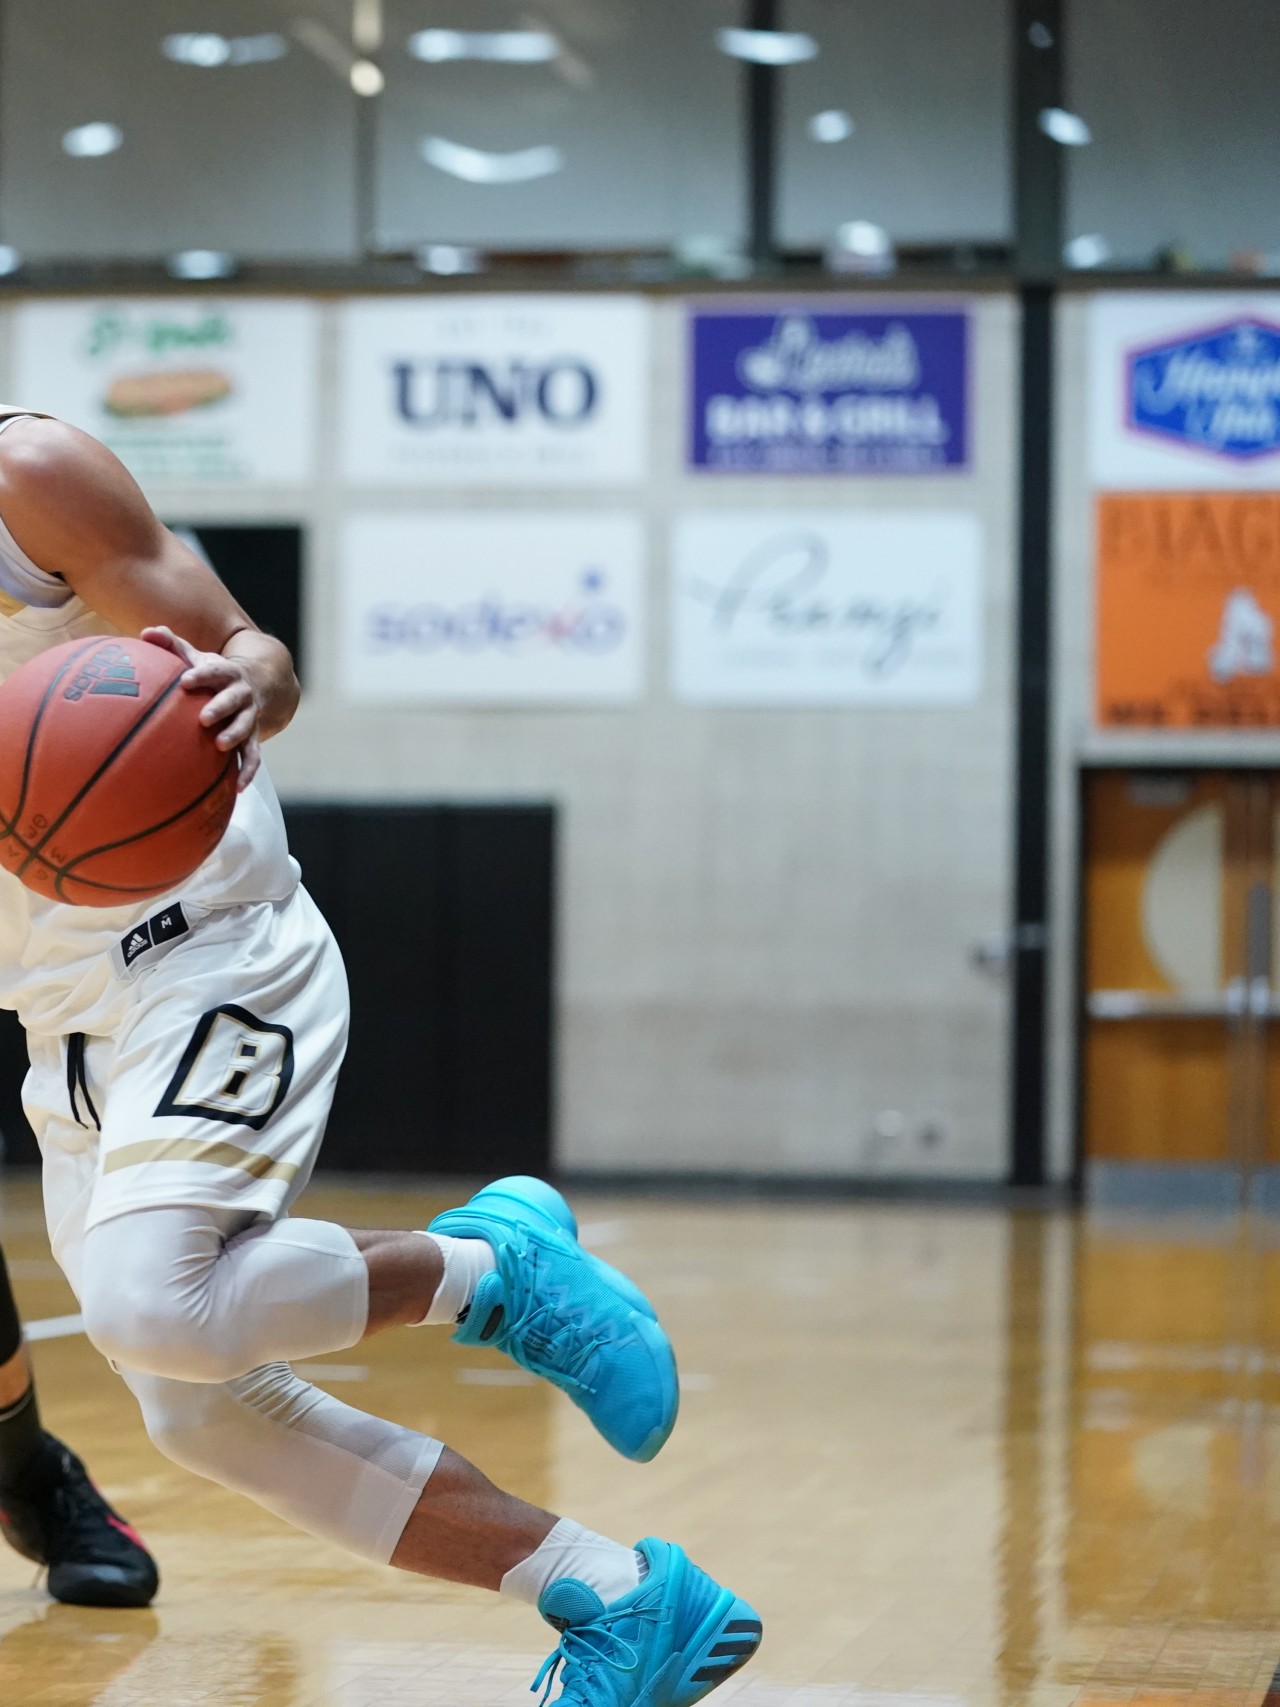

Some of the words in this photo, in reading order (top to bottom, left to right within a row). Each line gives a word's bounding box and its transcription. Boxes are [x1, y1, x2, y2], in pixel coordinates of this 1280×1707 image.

[390, 357, 600, 429] UNO
[63, 645, 124, 701] adidas
[161, 917, 172, 929] M
[154, 1005, 293, 1129] B
